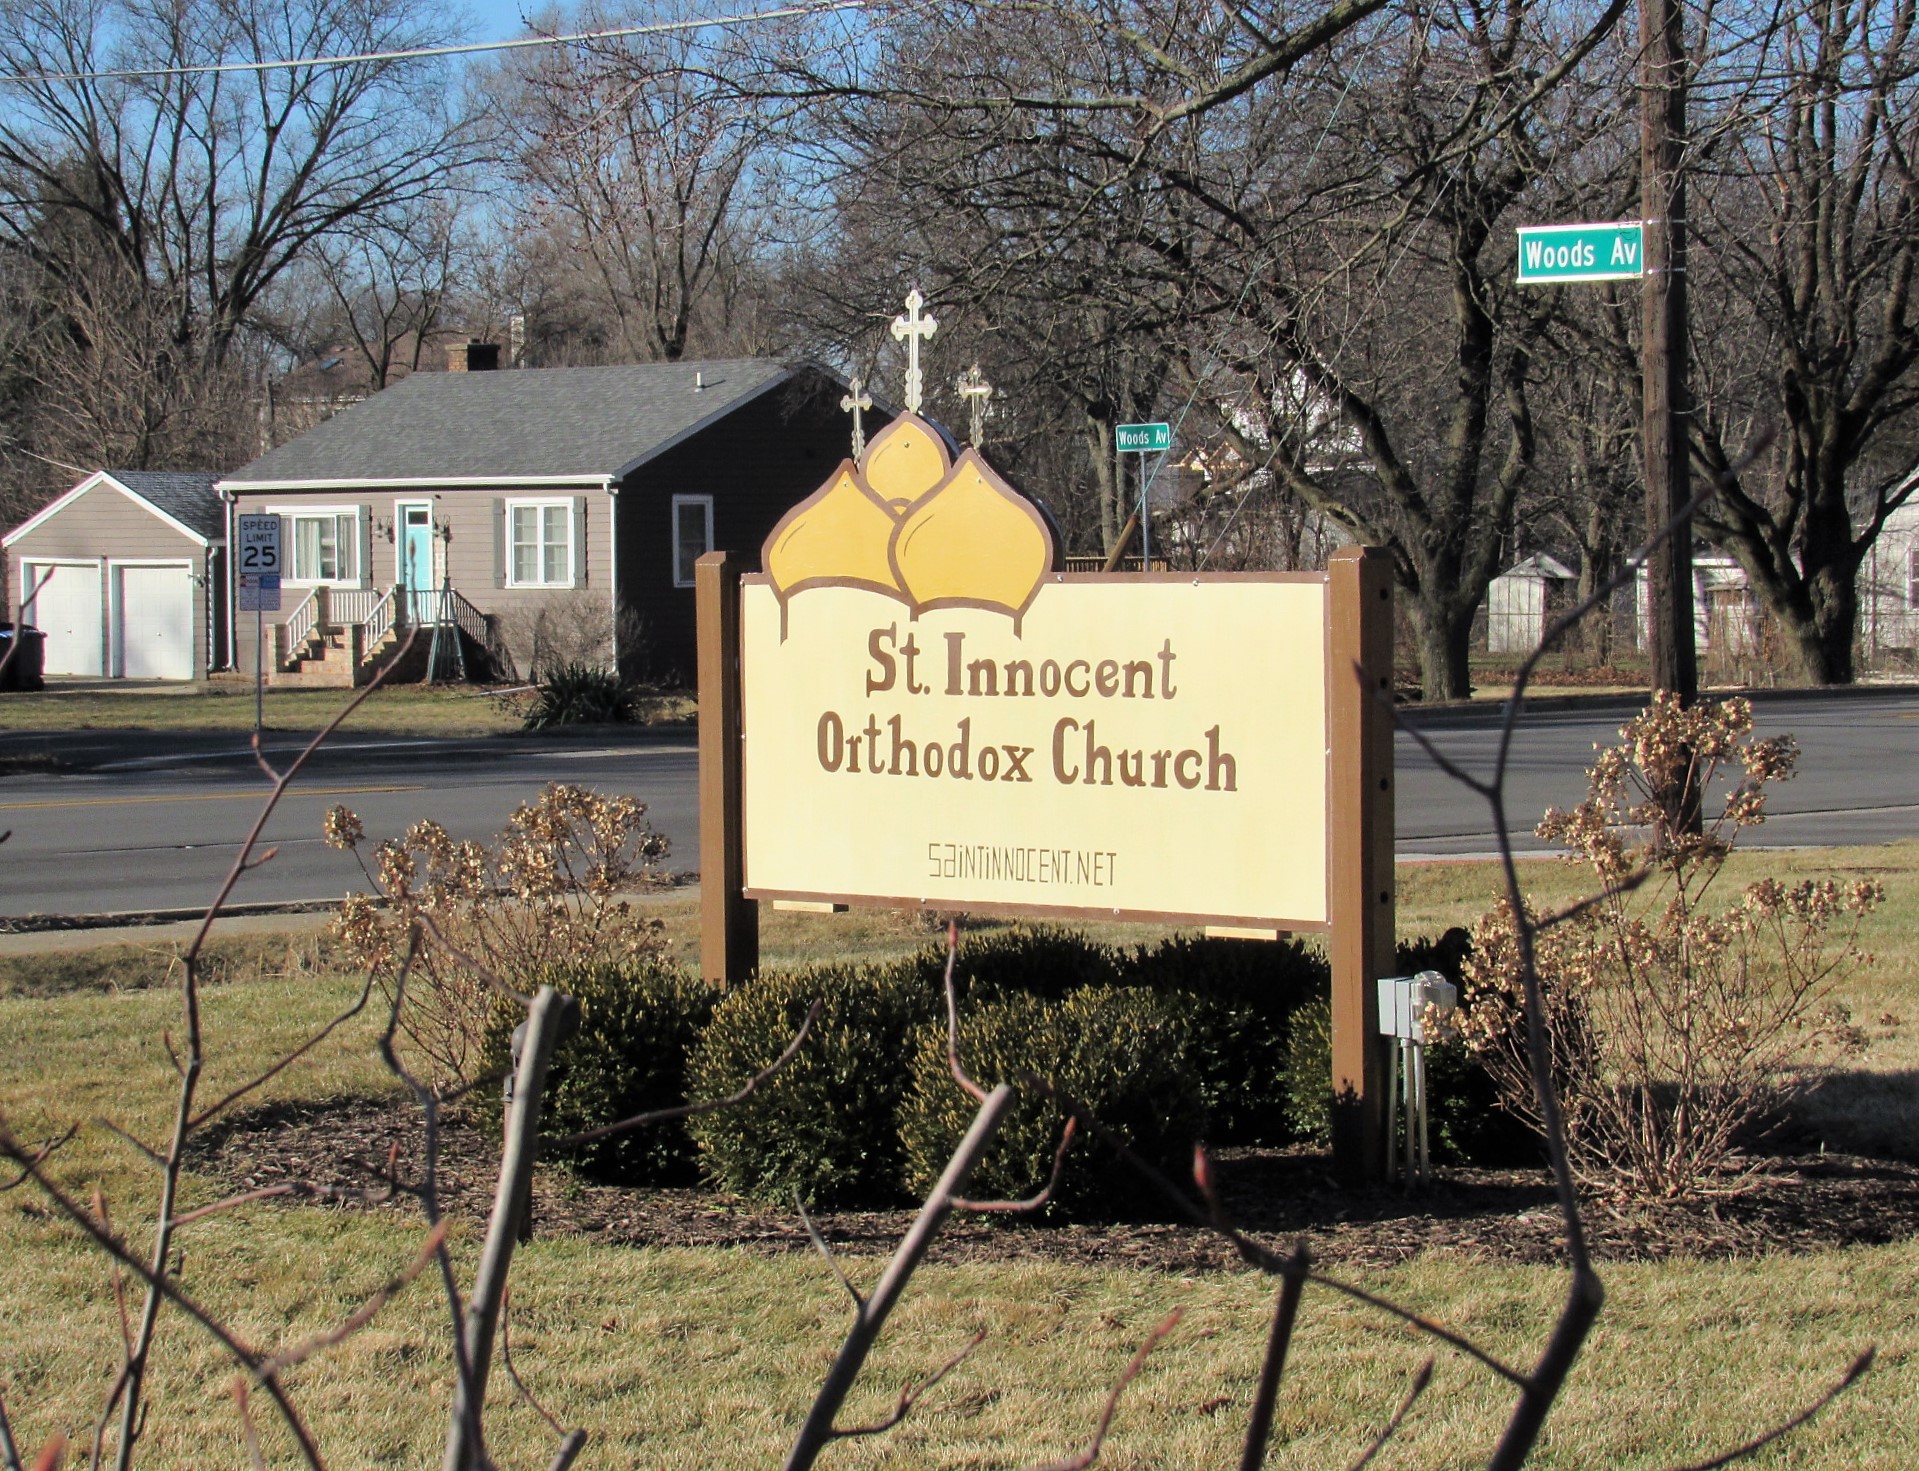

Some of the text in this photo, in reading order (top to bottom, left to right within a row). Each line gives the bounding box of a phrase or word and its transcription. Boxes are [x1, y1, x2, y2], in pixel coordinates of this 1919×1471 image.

[1526, 236, 1637, 270] Woods Av
[1119, 429, 1166, 446] Woods Av
[243, 521, 278, 531] SPEED
[246, 533, 273, 542] LIMIT
[244, 546, 276, 567] 25
[866, 621, 1177, 700] St. Innocent
[817, 710, 1238, 792] Orthodox Church
